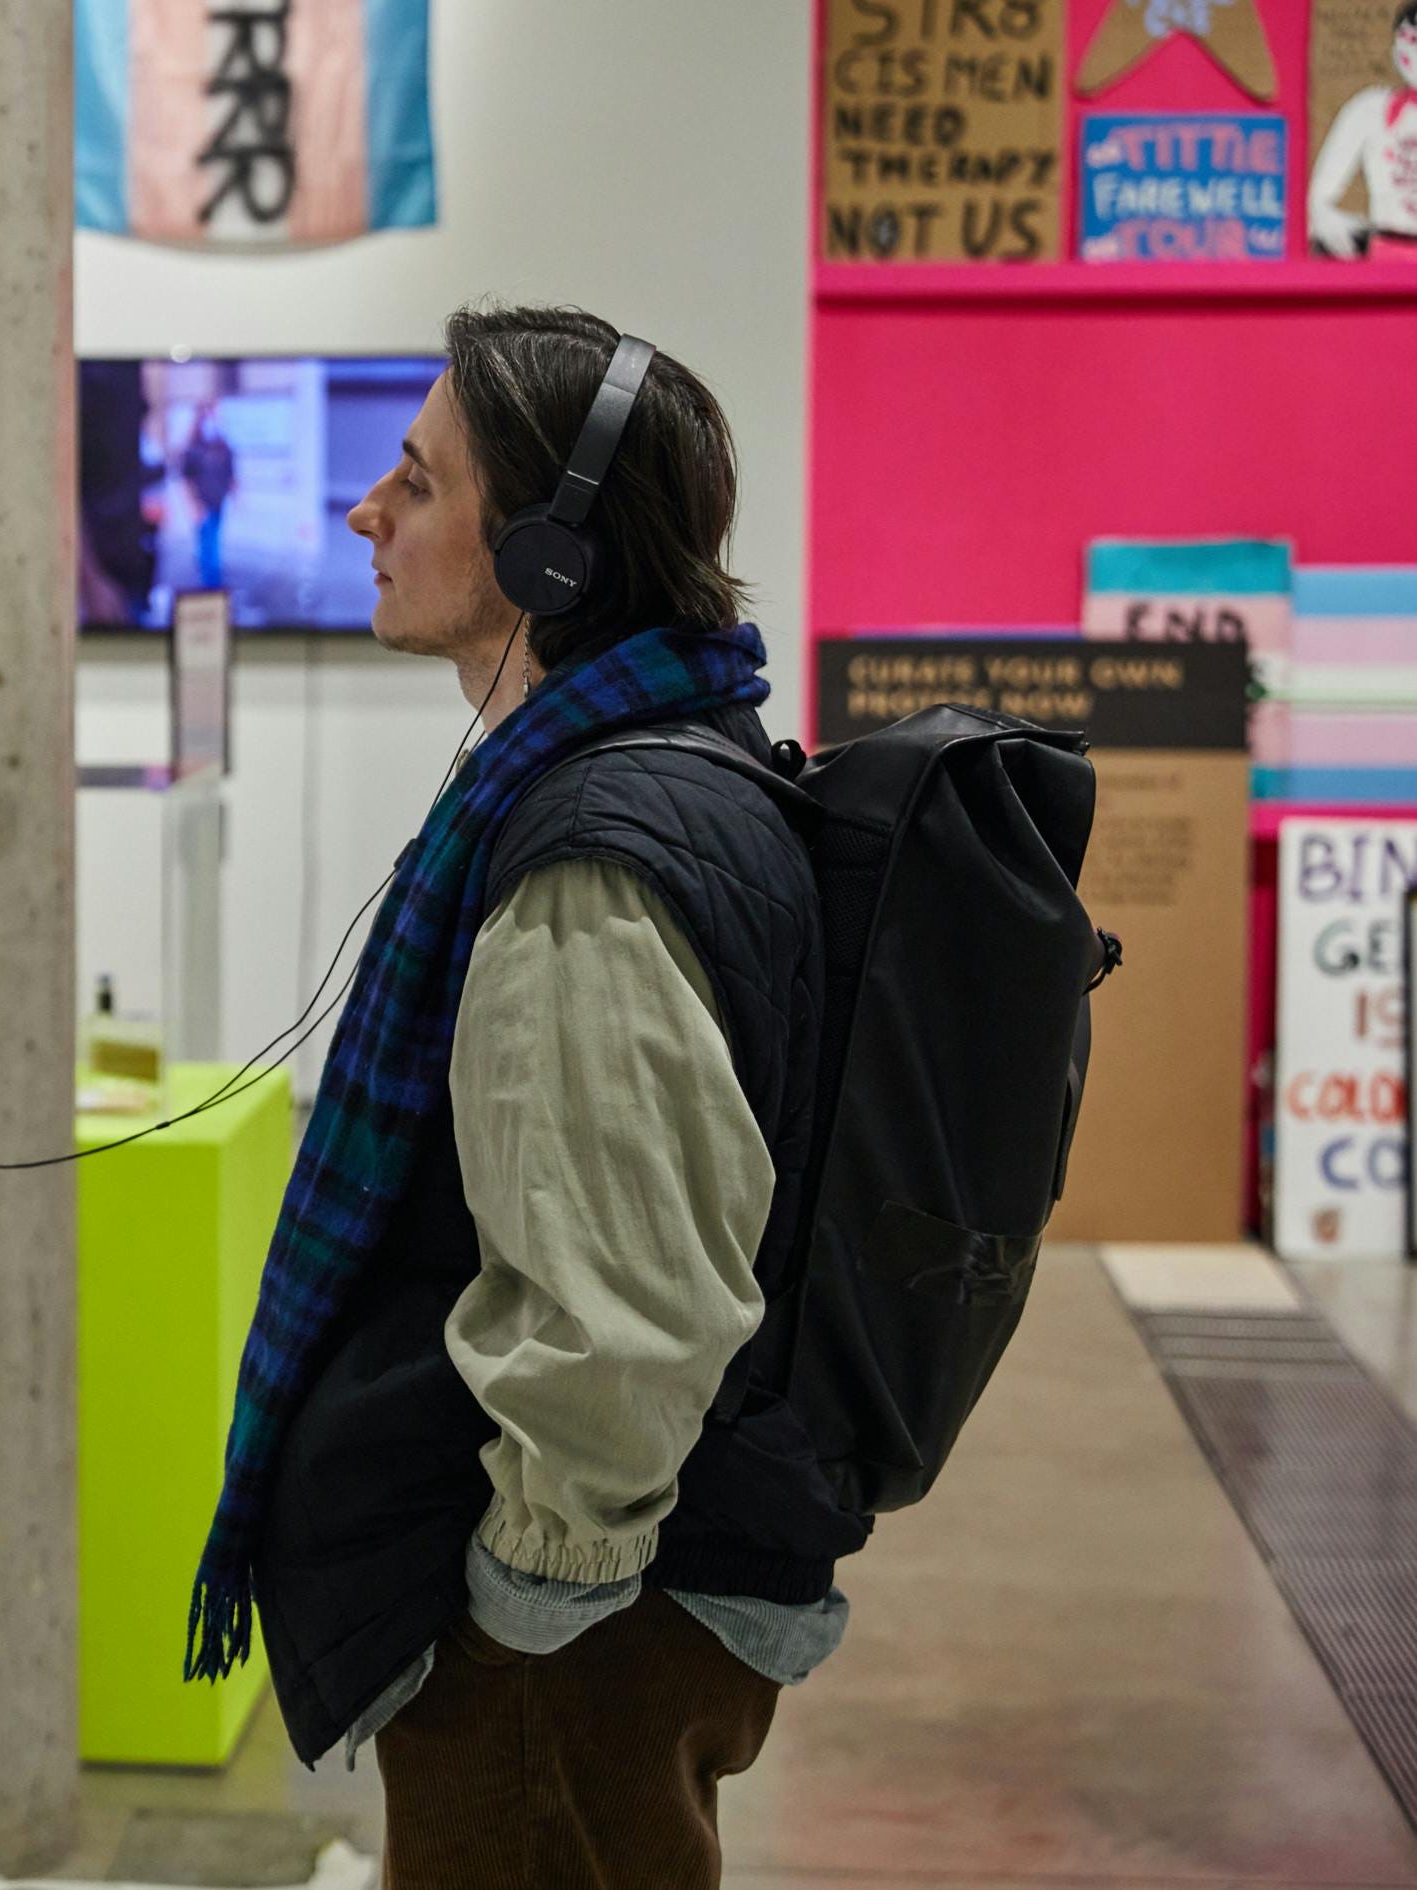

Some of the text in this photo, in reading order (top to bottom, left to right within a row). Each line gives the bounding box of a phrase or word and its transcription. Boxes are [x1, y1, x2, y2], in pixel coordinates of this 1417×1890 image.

[834, 48, 1054, 102] CIS MEN
[834, 103, 967, 147] NEED
[838, 148, 1056, 189] THERAPY
[828, 198, 1043, 261] NOT US
[544, 567, 578, 588] SONY
[1088, 657, 1184, 691] OWN
